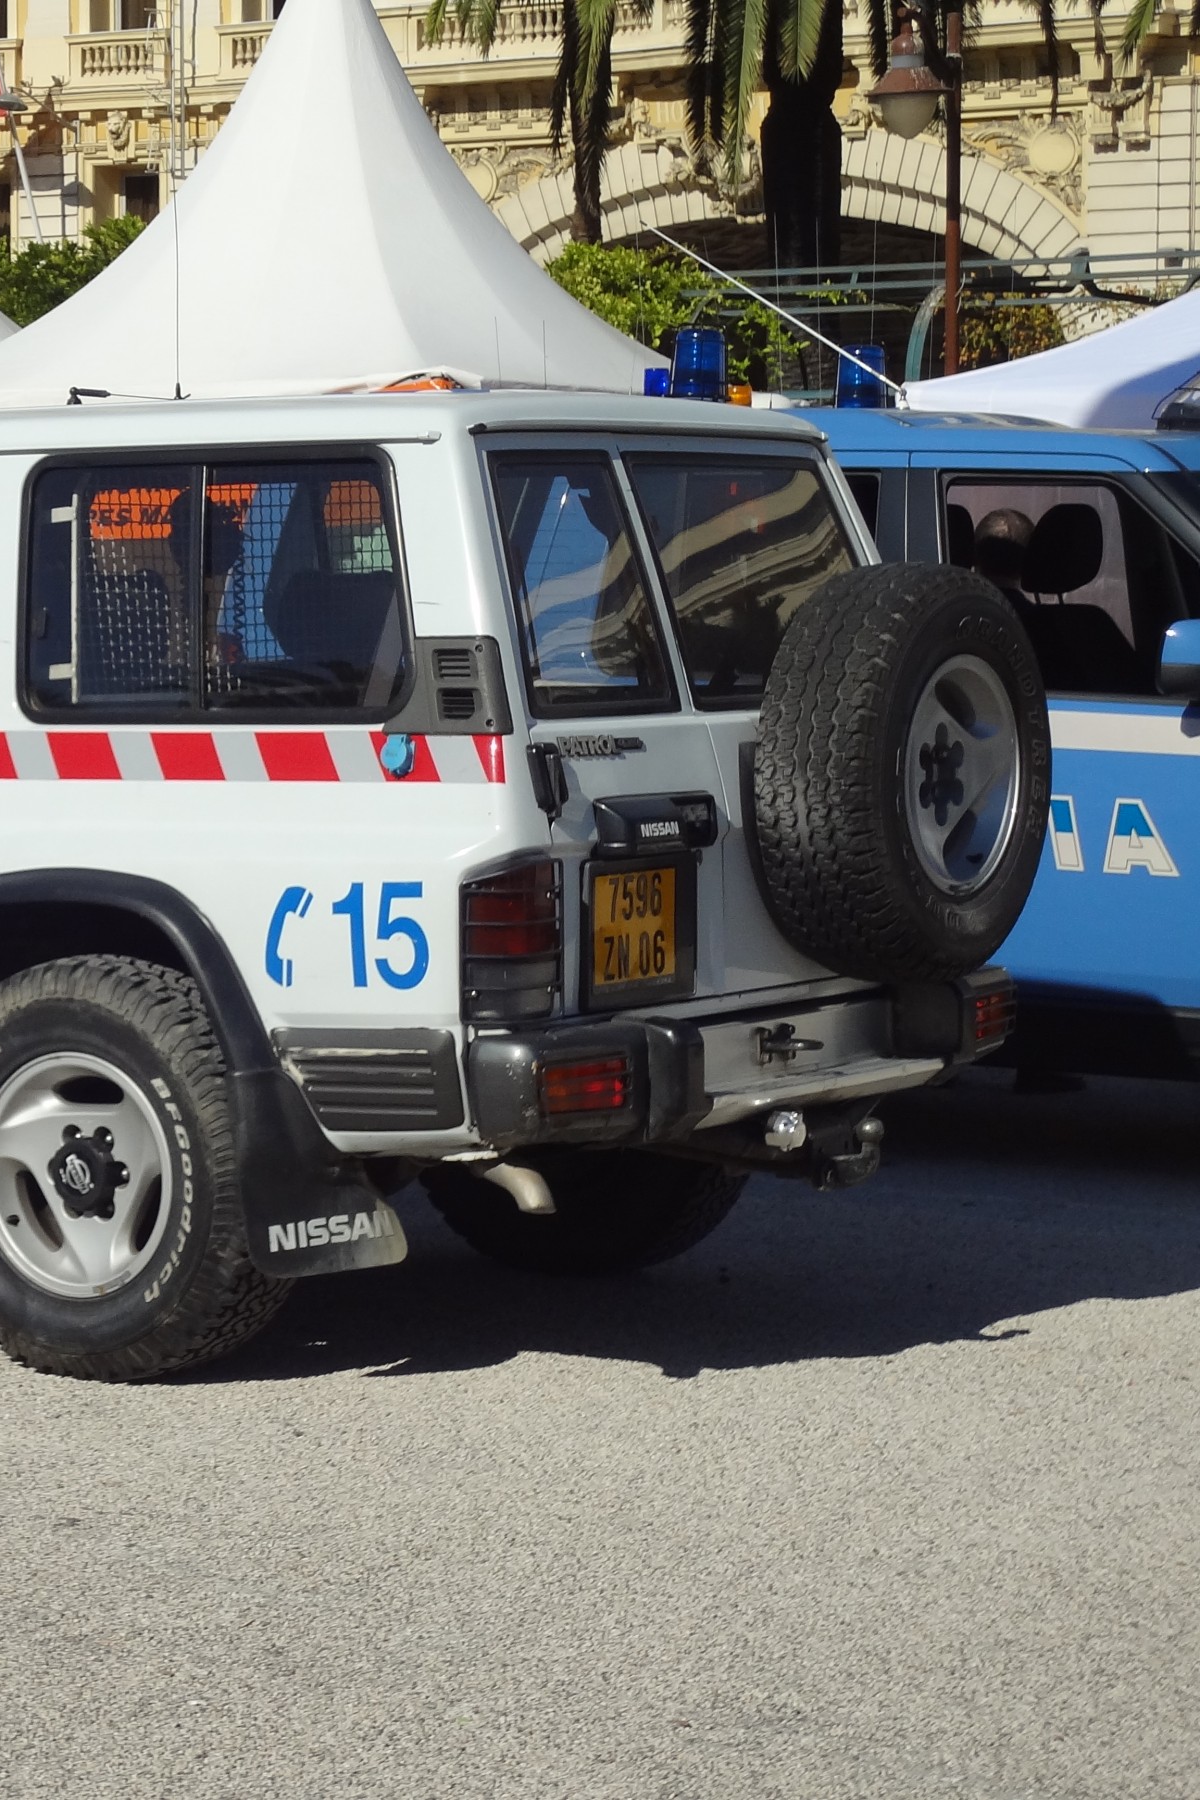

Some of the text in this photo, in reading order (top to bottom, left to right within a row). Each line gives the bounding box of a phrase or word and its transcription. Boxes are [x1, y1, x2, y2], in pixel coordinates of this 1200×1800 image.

[557, 734, 620, 756] PATROL
[640, 821, 680, 838] NISSAN
[608, 872, 662, 923] 7596
[332, 881, 430, 990] 15
[603, 929, 666, 981] ZN 06
[268, 1210, 395, 1253] NISSAN
